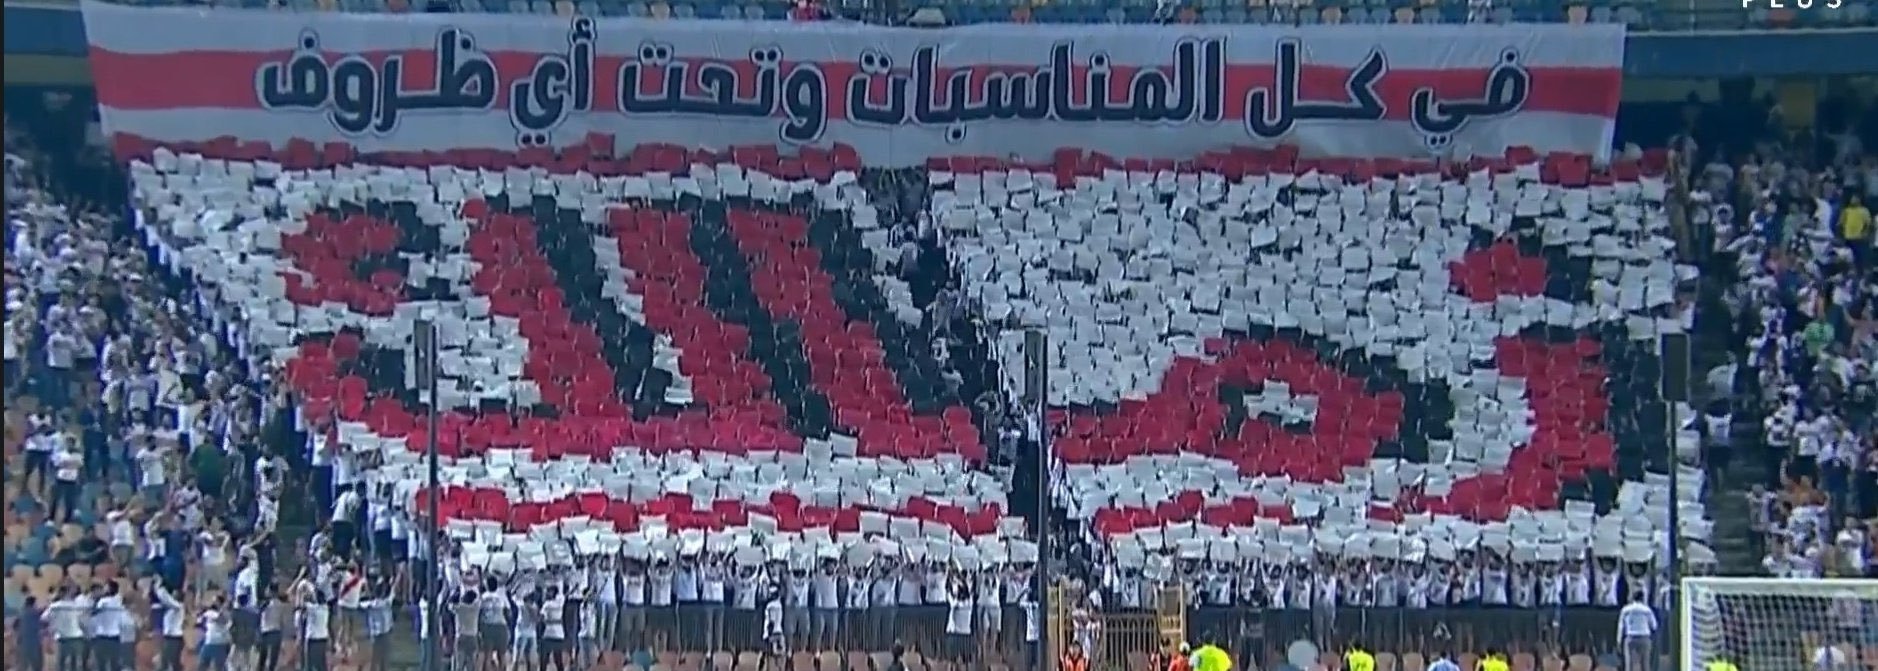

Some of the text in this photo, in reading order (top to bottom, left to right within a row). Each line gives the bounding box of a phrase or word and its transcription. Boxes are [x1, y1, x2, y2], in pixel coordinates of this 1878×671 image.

[259, 18, 1531, 147] في كل المناسبات وتحت أي ظروف
